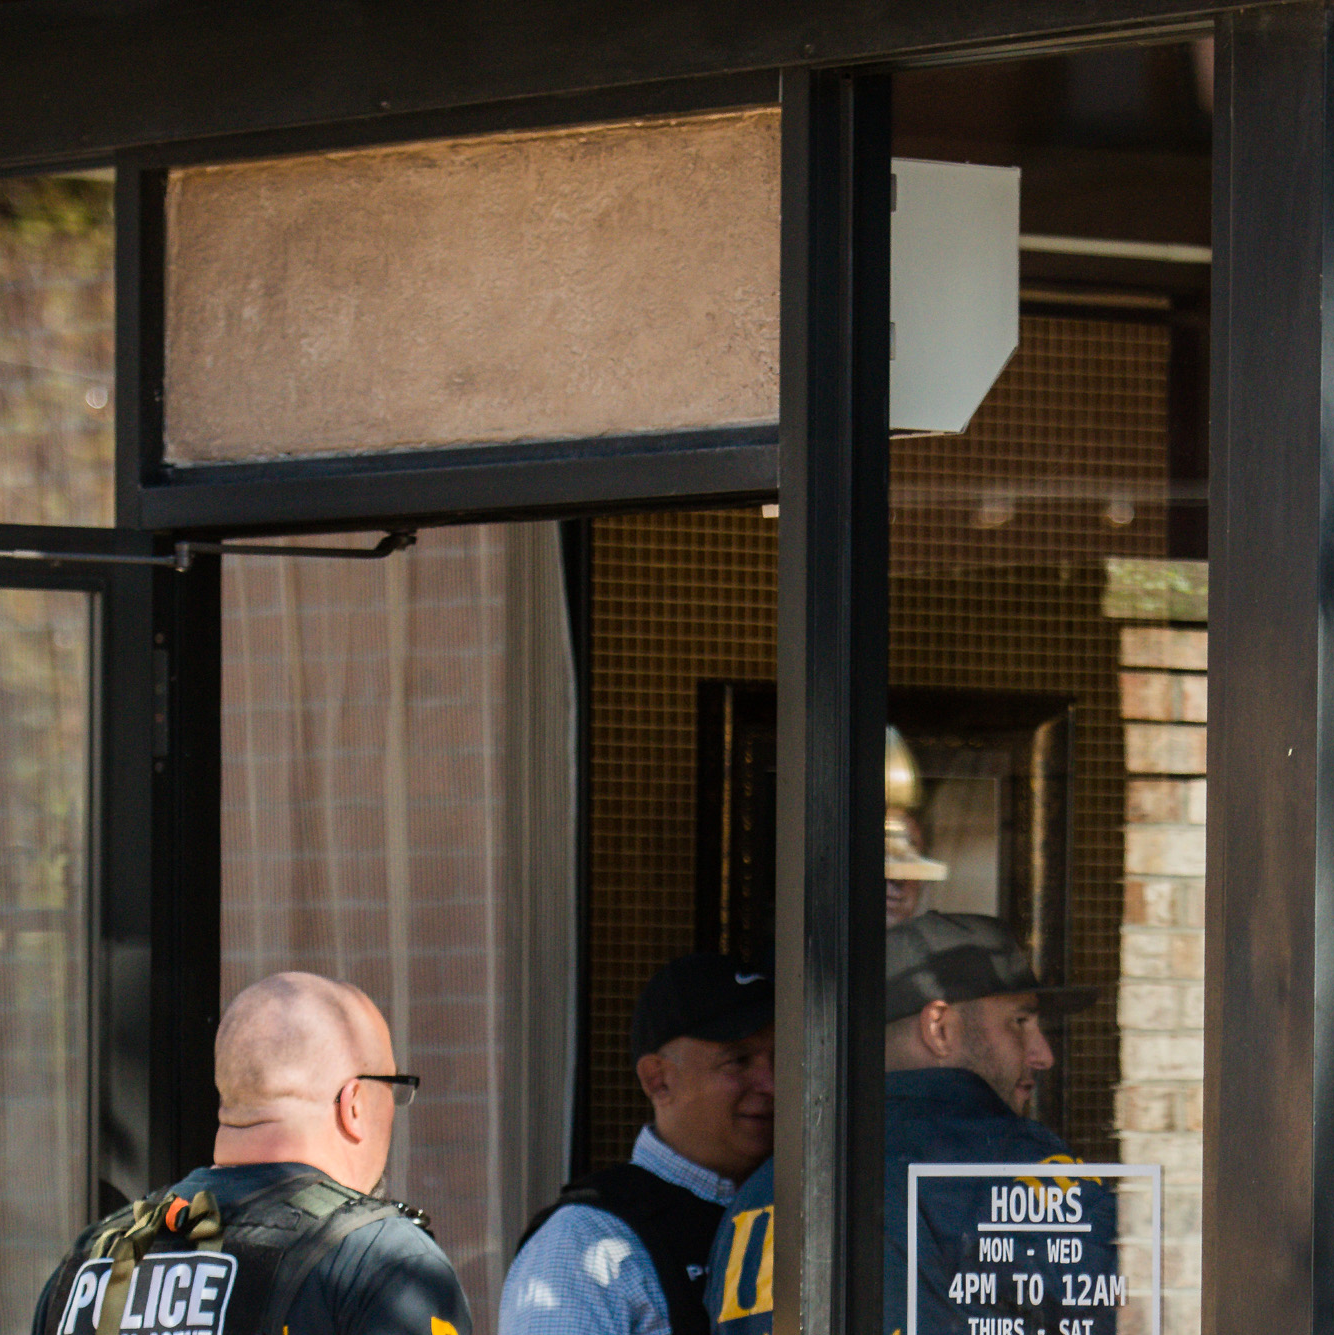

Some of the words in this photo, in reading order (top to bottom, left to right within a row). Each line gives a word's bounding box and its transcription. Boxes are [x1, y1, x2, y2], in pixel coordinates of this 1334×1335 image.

[991, 1186, 1083, 1223] HOURS
[979, 1238, 1014, 1263] MON
[1047, 1238, 1083, 1264] WED
[948, 1273, 996, 1305] 4PM
[1012, 1274, 1044, 1305] TO
[1062, 1274, 1126, 1307] 12AM
